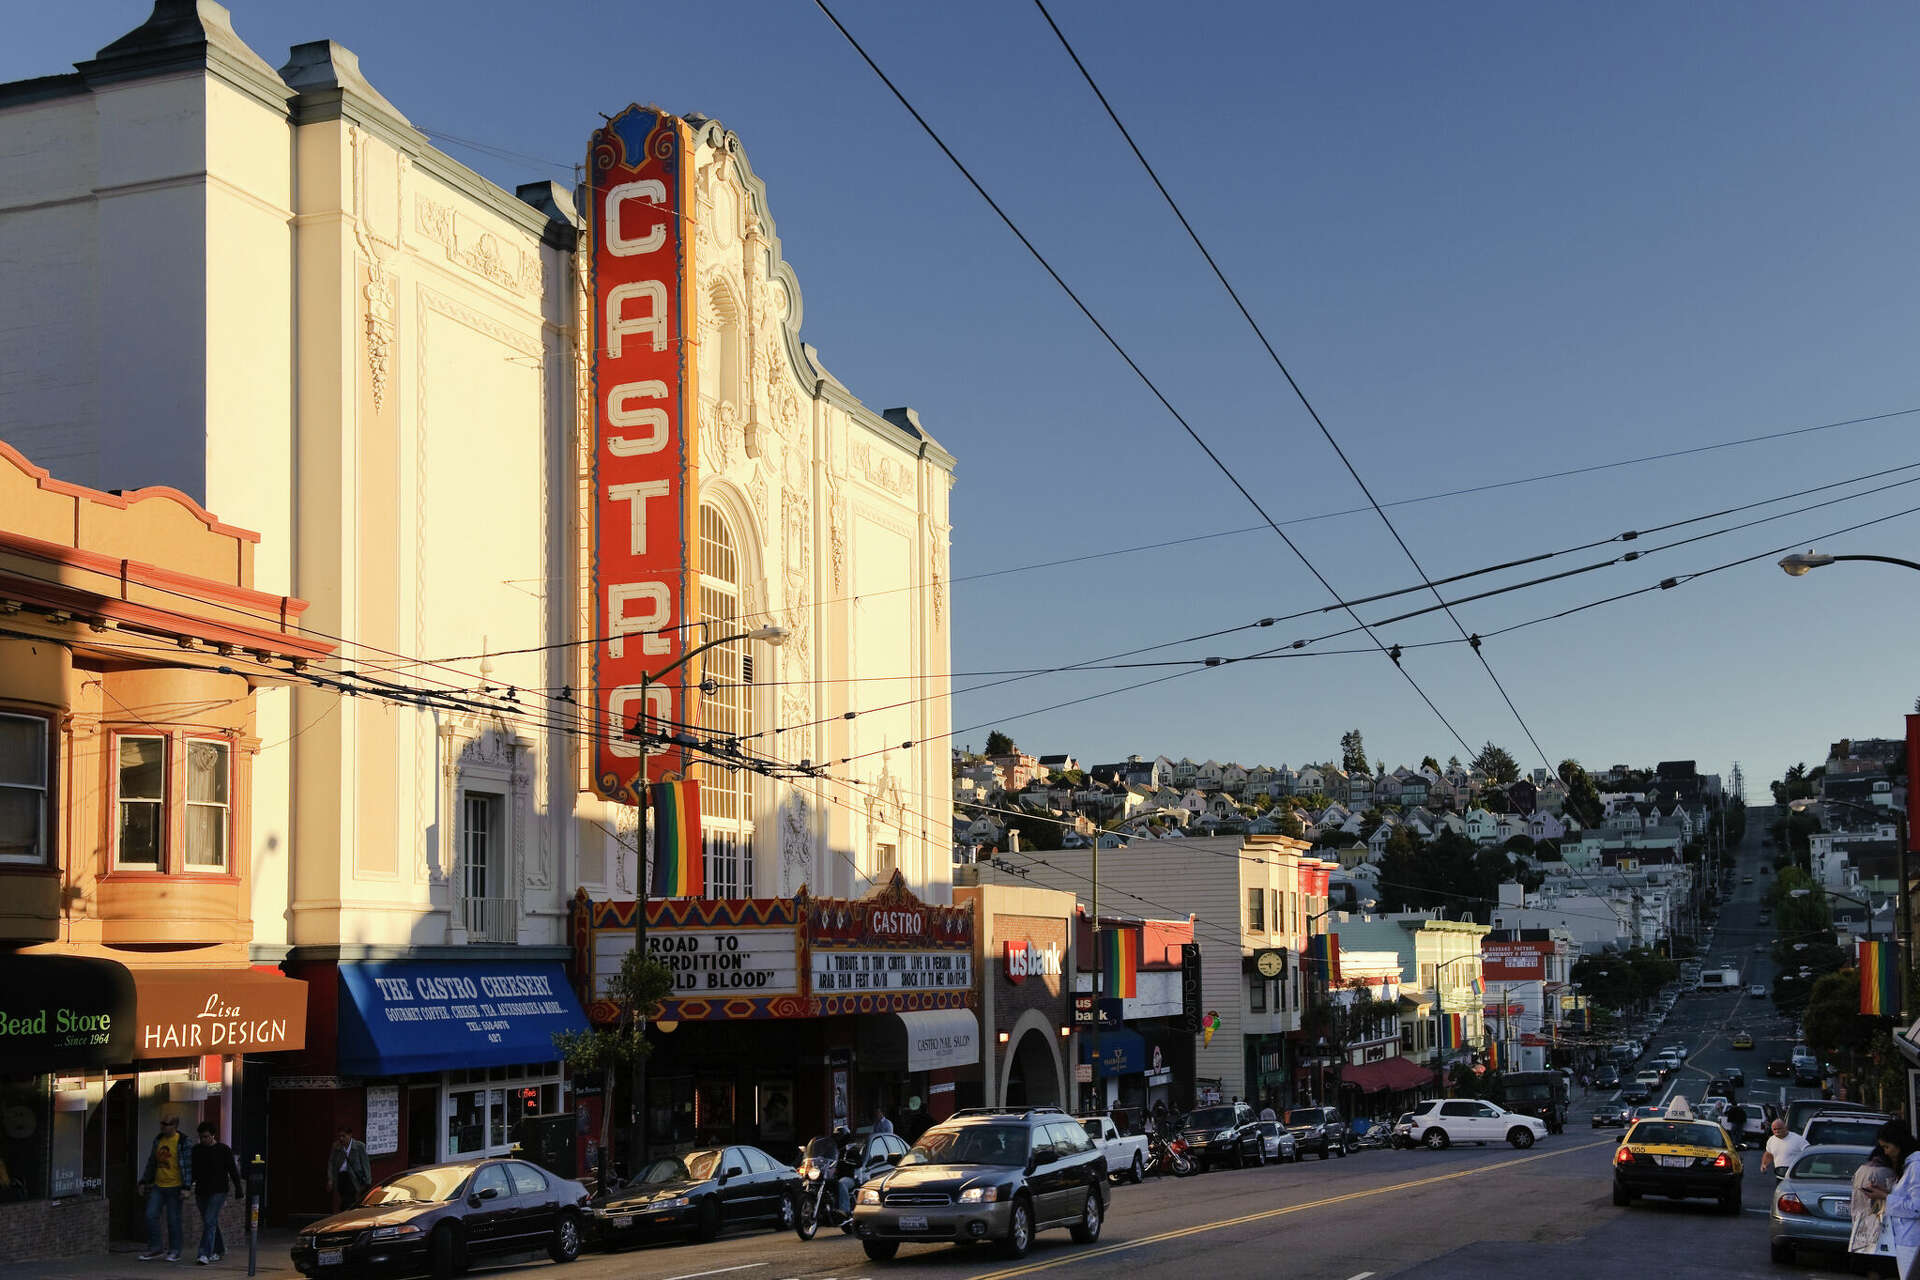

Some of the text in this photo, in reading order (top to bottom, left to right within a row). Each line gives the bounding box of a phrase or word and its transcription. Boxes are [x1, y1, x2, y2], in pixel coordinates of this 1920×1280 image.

[605, 179, 672, 759] CASTRO
[873, 911, 921, 935] CASTRO
[715, 936, 739, 951] TO
[834, 956, 859, 970] TRIBUTE
[911, 956, 923, 969] LIVE
[374, 975, 553, 1001] THE CASTRO CHEESERY
[819, 973, 835, 988] ARAB
[855, 973, 870, 987] FEST
[197, 993, 241, 1018] Lisa
[1075, 999, 1092, 1008] us
[55, 1009, 111, 1033] Store
[1075, 1009, 1108, 1021] bak
[89, 1033, 110, 1046] 1964
[144, 1019, 286, 1049] HAIR DESIGN
[917, 1038, 939, 1051] CASTRO
